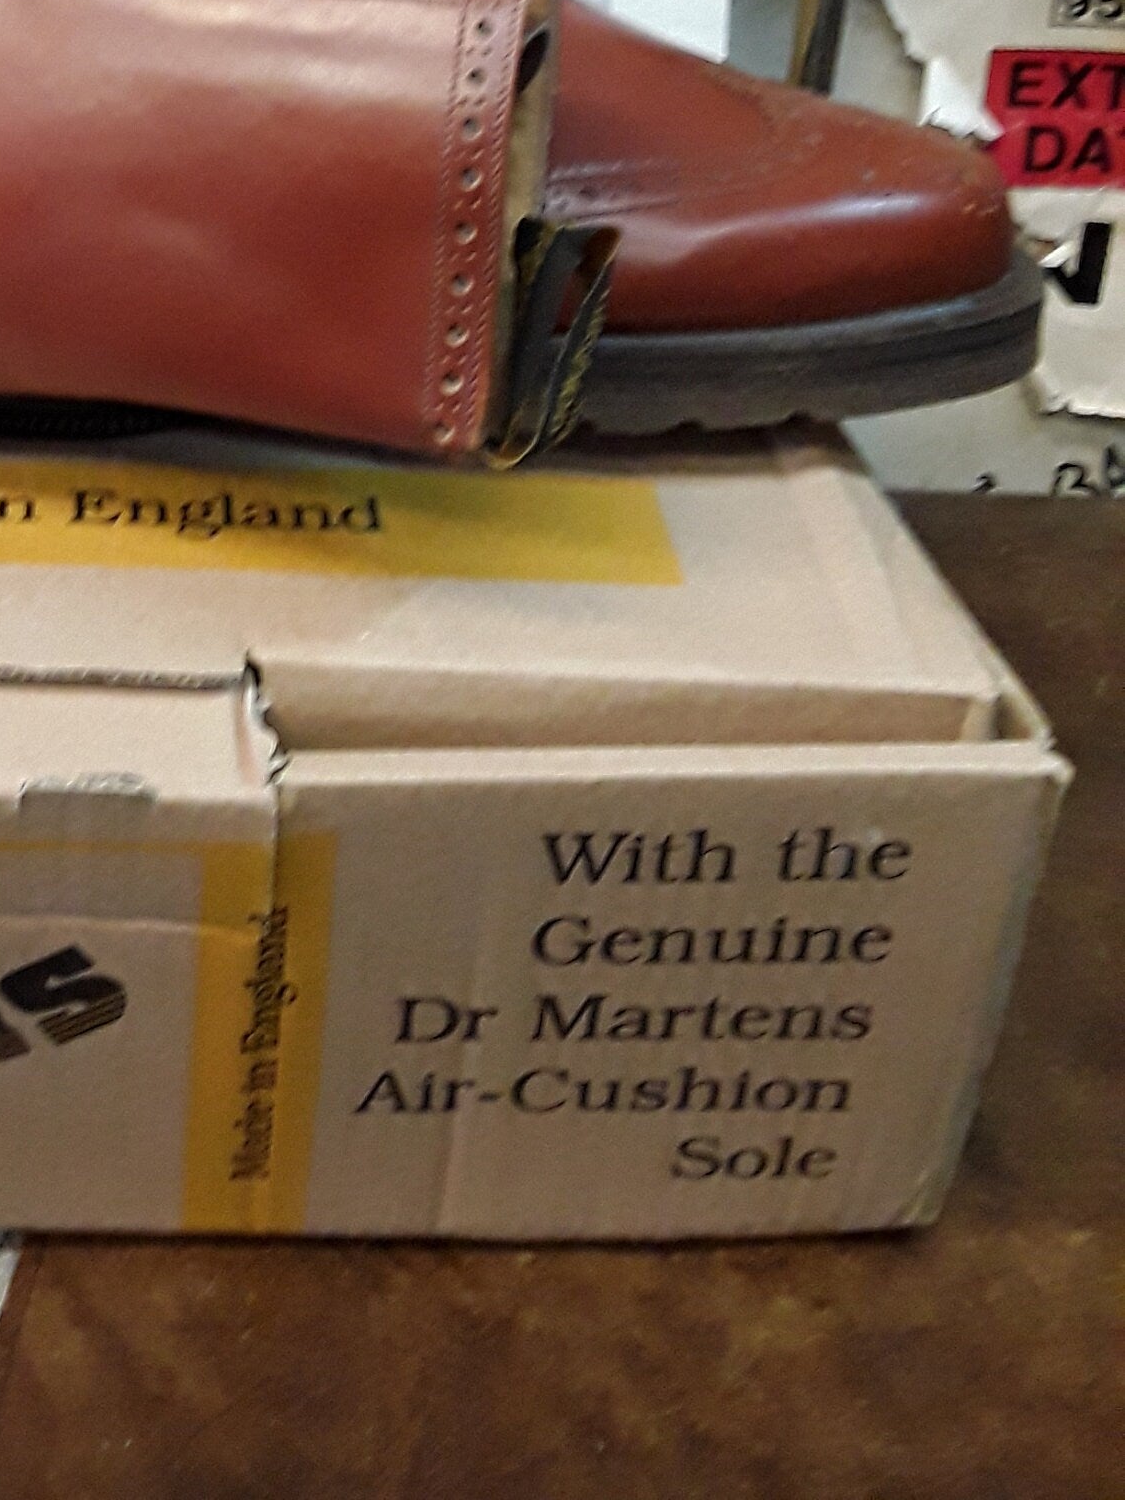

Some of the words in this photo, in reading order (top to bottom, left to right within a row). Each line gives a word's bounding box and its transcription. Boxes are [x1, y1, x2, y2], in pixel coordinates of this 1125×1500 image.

[67, 487, 384, 538] England
[543, 828, 737, 885] With
[776, 825, 914, 882] the
[530, 914, 894, 967] Genuine
[240, 905, 297, 1055] England
[393, 995, 498, 1043] Dr
[530, 993, 873, 1044] Martens
[352, 1065, 852, 1116] Air-Cushion
[671, 1133, 838, 1180] Sole
